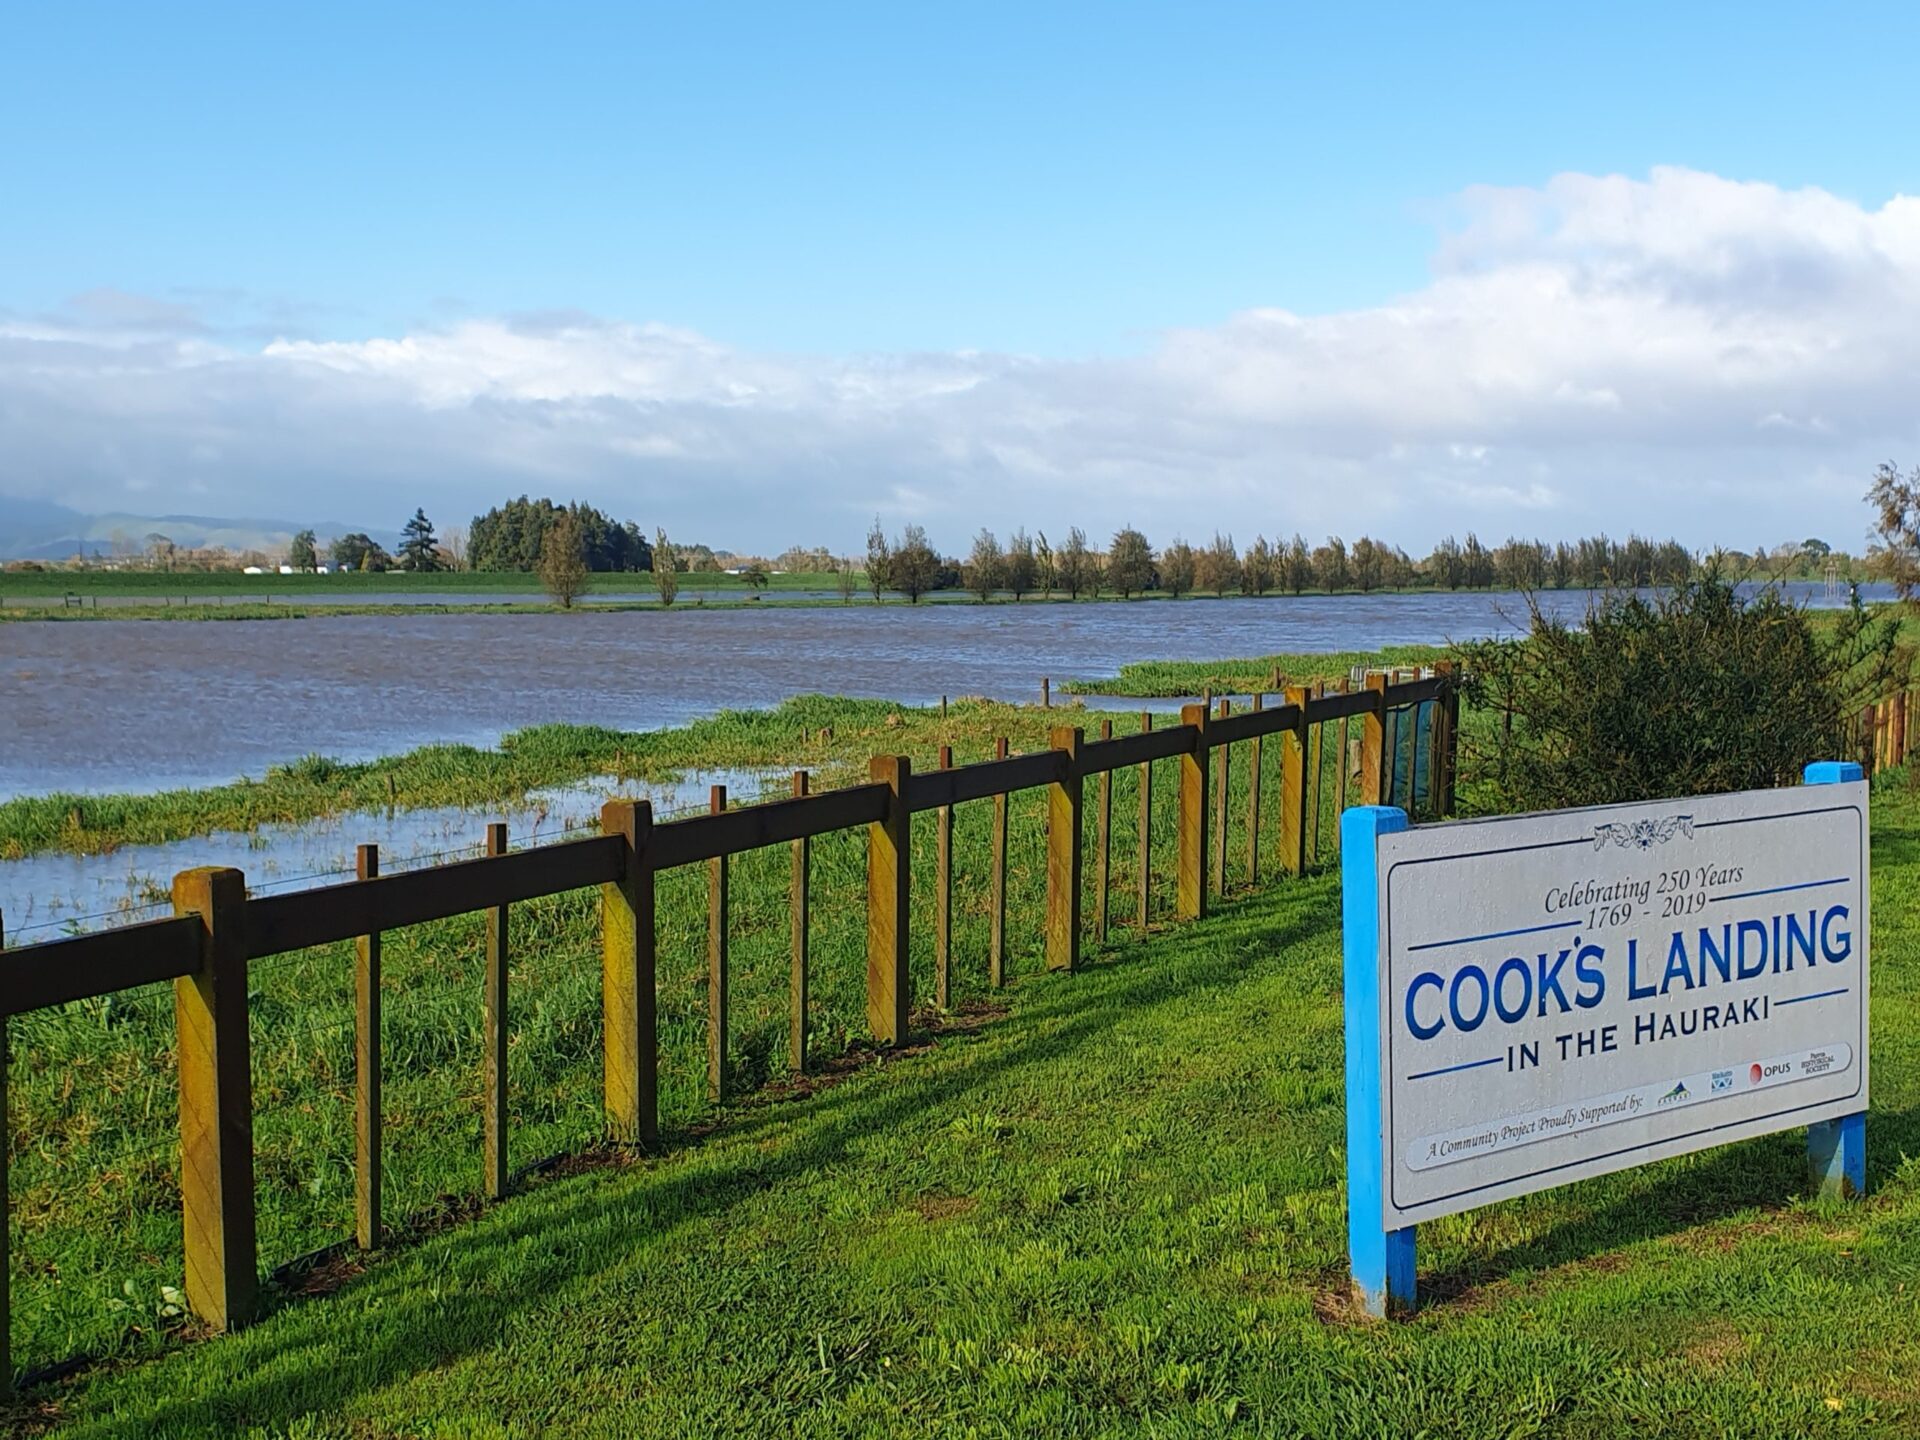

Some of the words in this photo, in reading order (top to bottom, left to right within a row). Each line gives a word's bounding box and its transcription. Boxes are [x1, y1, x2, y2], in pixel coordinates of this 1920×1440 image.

[1545, 877, 1650, 913] Celebrating
[1657, 869, 1690, 894] 250
[1696, 864, 1744, 887] Years
[1586, 903, 1632, 930] 1769
[1661, 892, 1706, 918] 2019
[1405, 936, 1605, 1041] COOK'S
[1628, 905, 1852, 1001] LANDING
[1507, 1041, 1539, 1072] IN
[1556, 1025, 1618, 1061] THE
[1634, 995, 1769, 1046] HAURAKI
[1764, 1062, 1791, 1077] OPUS
[1806, 1063, 1830, 1074] SOCIETY
[1426, 1143, 1437, 1160] A
[1440, 1130, 1499, 1156] Community
[1501, 1121, 1536, 1142] Project
[1538, 1108, 1577, 1129] Proudly
[1578, 1095, 1629, 1123] Supported
[1629, 1094, 1643, 1113] by:
